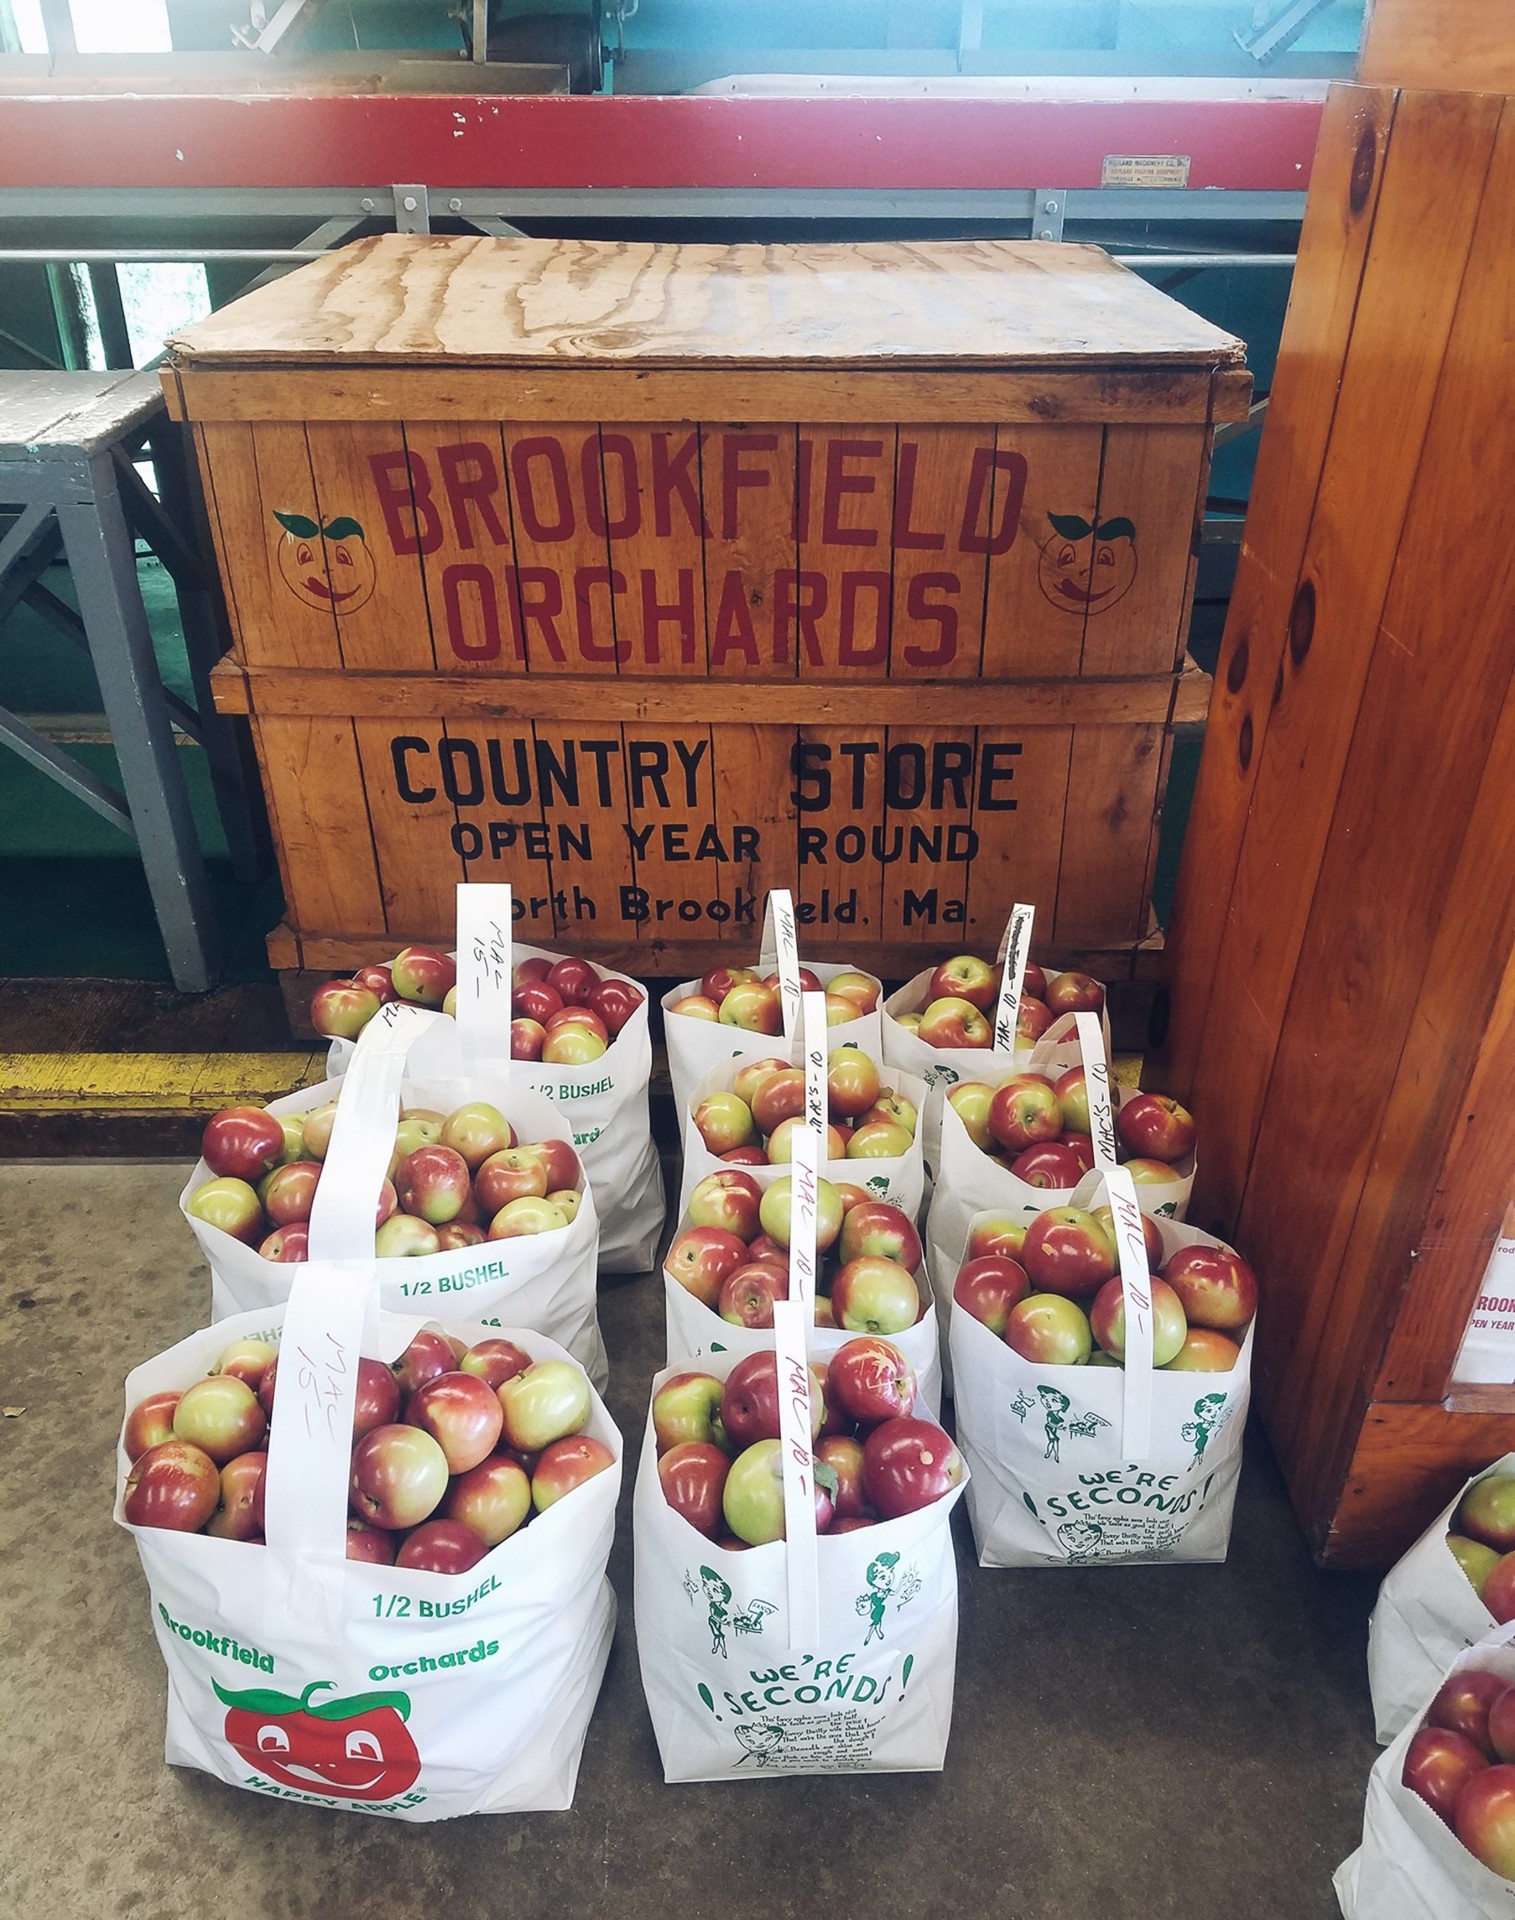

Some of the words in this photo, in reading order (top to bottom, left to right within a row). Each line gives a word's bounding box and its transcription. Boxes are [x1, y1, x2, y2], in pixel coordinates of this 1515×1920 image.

[368, 433, 1028, 556] BROOKFIELD
[442, 563, 961, 667] ORCHARDS
[391, 736, 709, 809] COUNTRY
[790, 742, 1023, 812] STORE
[450, 822, 593, 861] OPEN
[622, 823, 761, 864] YEAR
[800, 825, 979, 865] ROUND
[510, 886, 597, 920] orth
[619, 885, 870, 926] Brookeld,
[902, 888, 977, 927] Ma.
[996, 1014, 1010, 1052] MAC
[559, 1075, 615, 1100] BUSHEL
[399, 1282, 433, 1298] 1/2
[438, 1261, 510, 1294] BUSHEL
[1476, 1295, 1515, 1313] ROOK
[1490, 1319, 1515, 1331] YEAR
[1078, 1464, 1179, 1491] WE'RE
[372, 1593, 411, 1618] 1/2
[418, 1574, 503, 1619] BUSHEL
[158, 1601, 276, 1675] Brookfield
[368, 1639, 500, 1681] Orchards
[749, 1653, 856, 1684] WE'RE
[244, 1776, 338, 1806] HAPPY
[351, 1792, 427, 1813] APPLE
